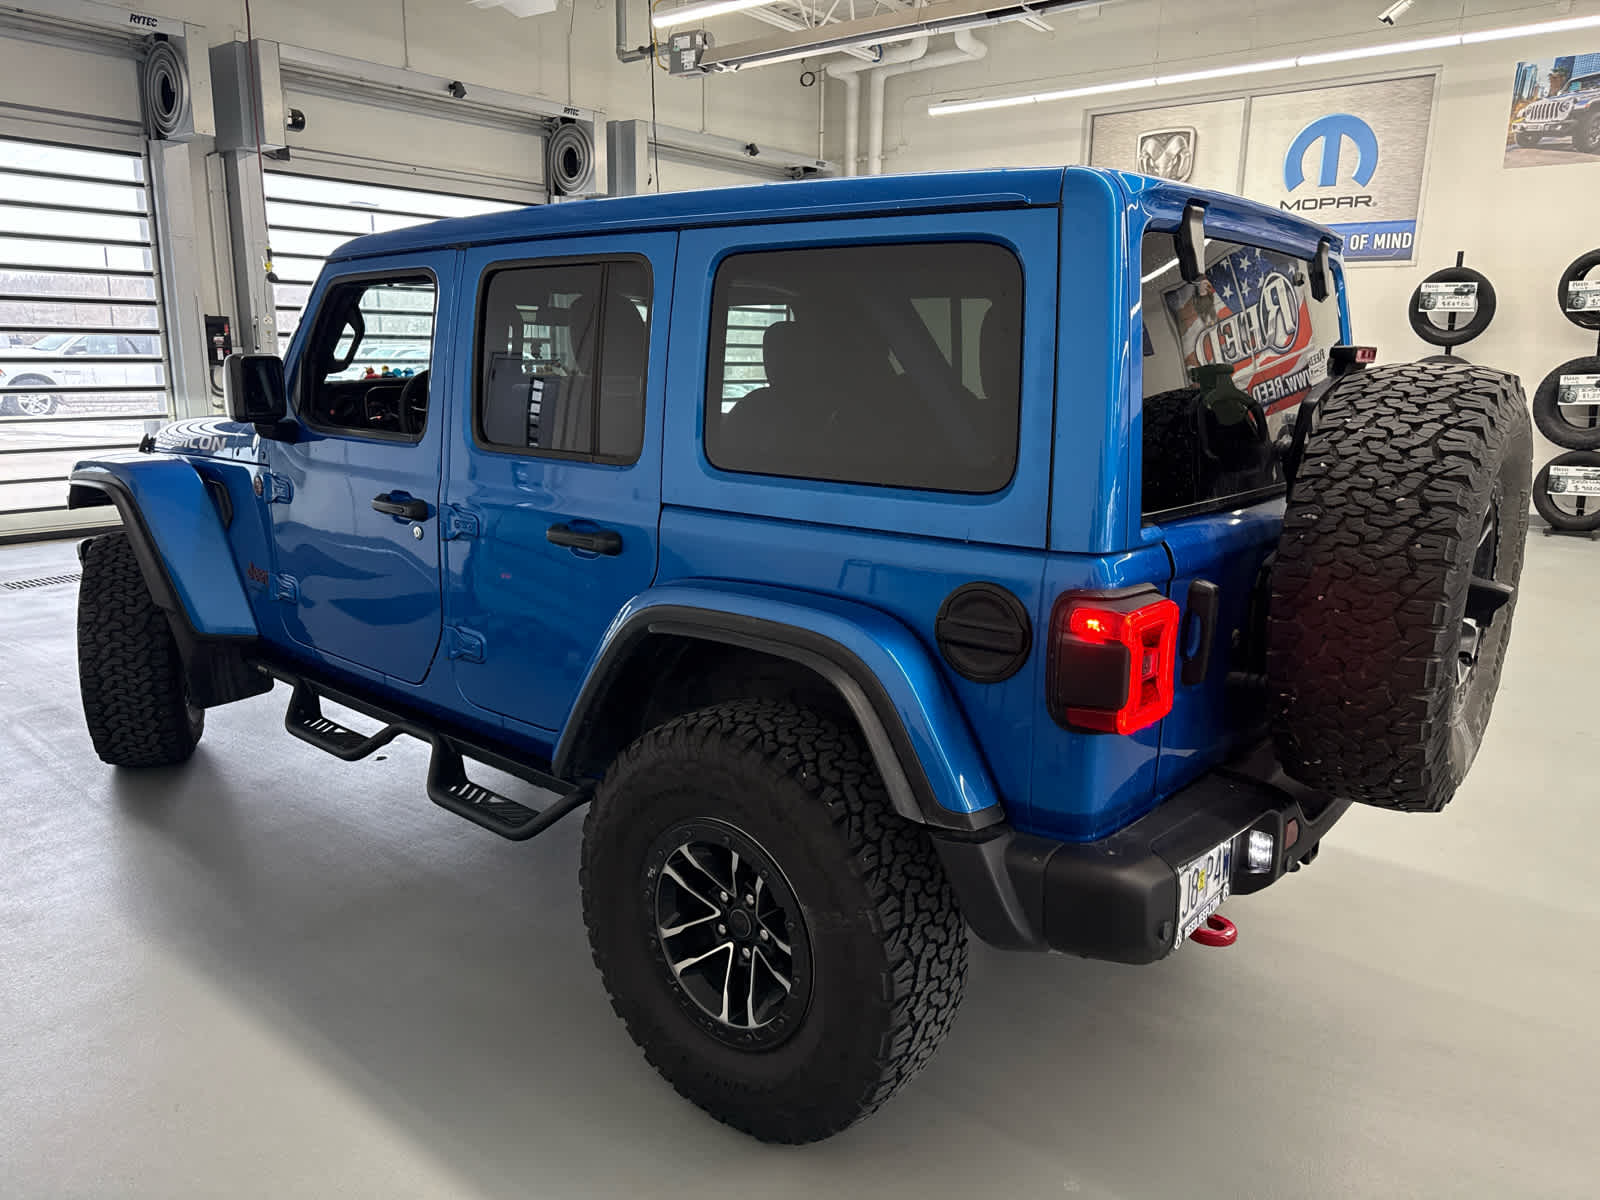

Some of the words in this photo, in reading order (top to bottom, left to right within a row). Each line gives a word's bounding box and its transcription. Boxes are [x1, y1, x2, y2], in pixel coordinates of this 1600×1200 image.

[129, 13, 158, 28] RYTEC
[1279, 194, 1373, 211] MOPAR
[1349, 233, 1369, 251] OF
[1373, 231, 1413, 250] MIND
